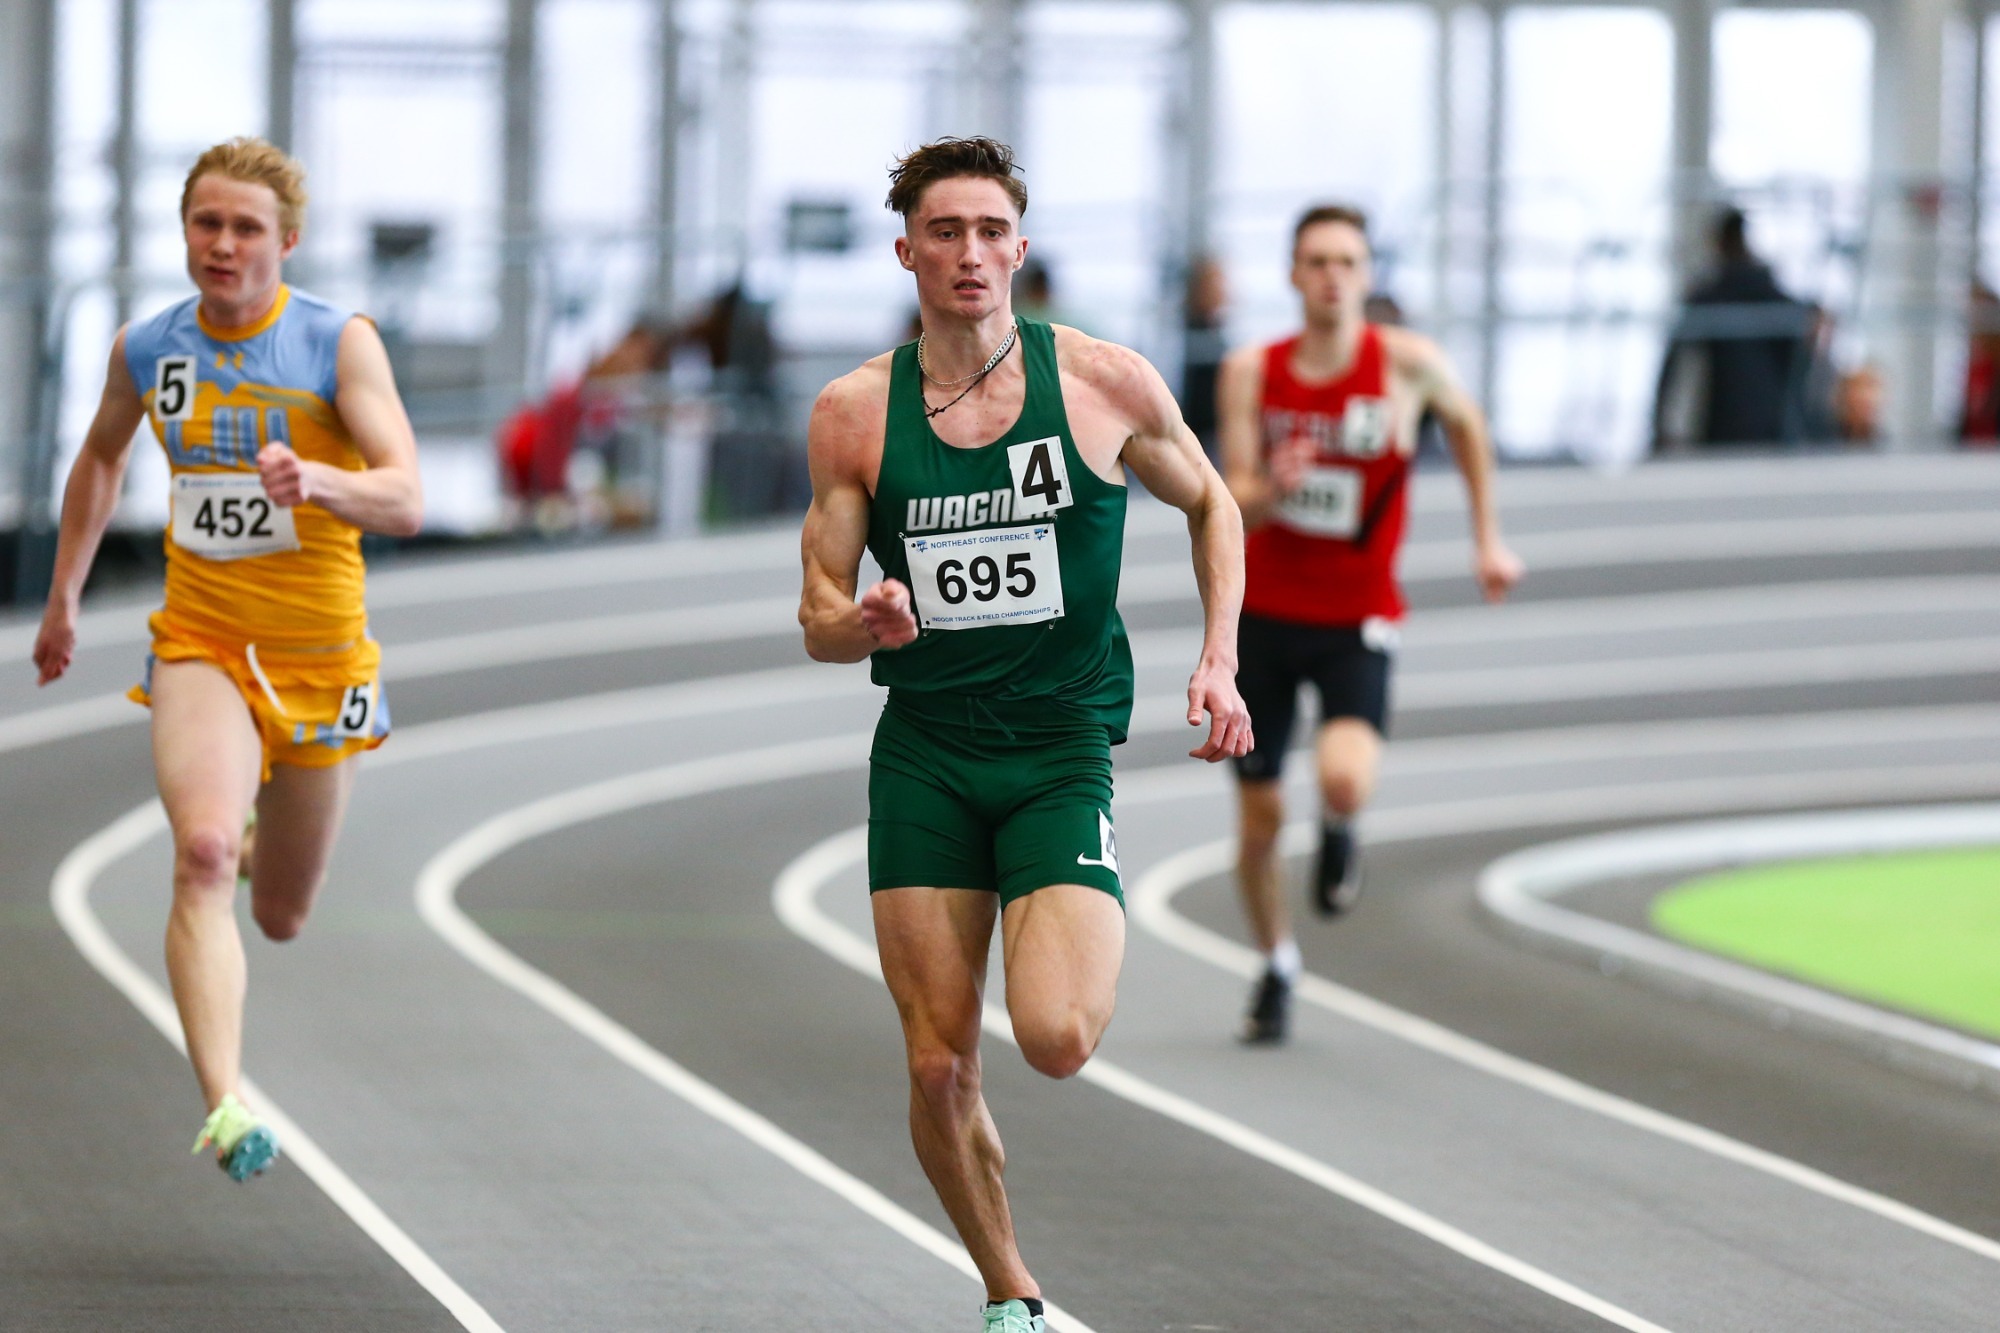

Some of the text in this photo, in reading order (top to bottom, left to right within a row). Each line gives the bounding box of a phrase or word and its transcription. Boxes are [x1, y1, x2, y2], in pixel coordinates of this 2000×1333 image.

[160, 362, 186, 415] 5
[1021, 443, 1062, 506] 4
[193, 497, 273, 538] 452
[906, 488, 1057, 531] WAGN
[930, 532, 1030, 549] NORTHEAST CONFERENCE
[936, 552, 1036, 604] 695
[954, 615, 976, 623] TRACK
[982, 613, 1000, 621] FIELD
[1001, 606, 1051, 619] CHAMPIONSHIPS
[343, 683, 367, 731] 5
